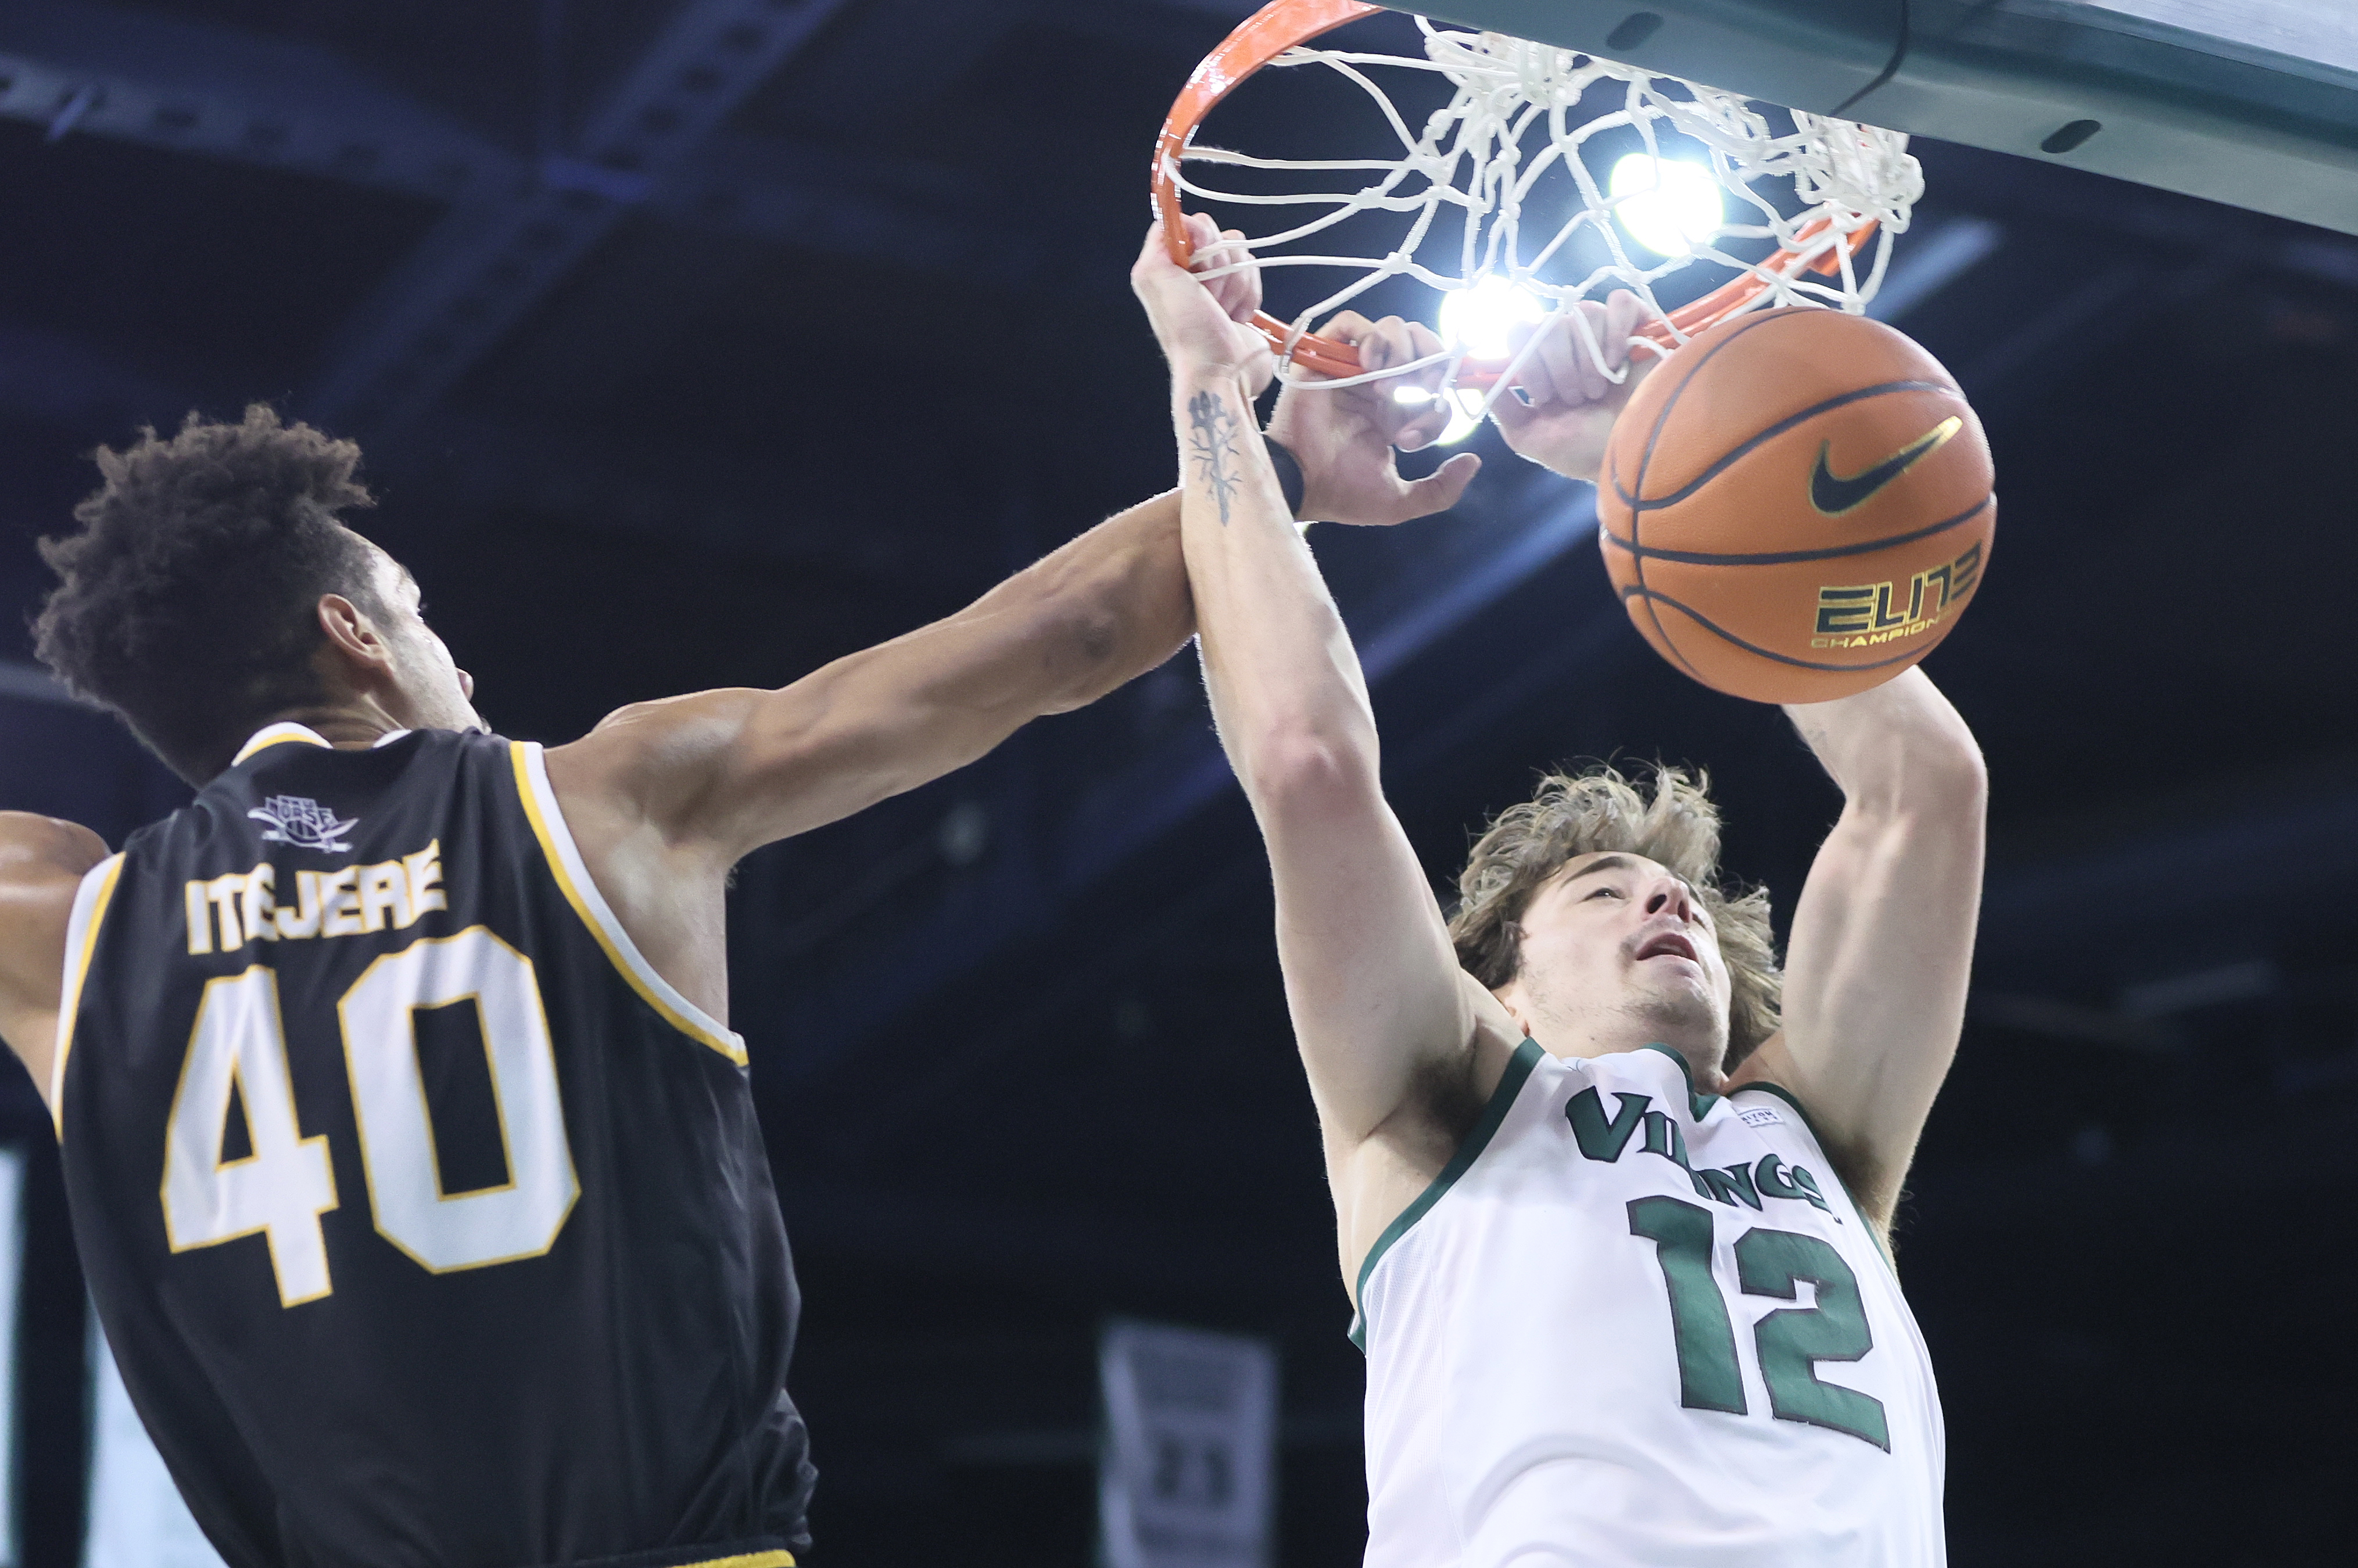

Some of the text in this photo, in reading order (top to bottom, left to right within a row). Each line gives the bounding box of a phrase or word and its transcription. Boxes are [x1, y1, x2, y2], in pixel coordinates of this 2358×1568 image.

[1811, 609, 1951, 649] CHAMPION
[1814, 540, 1981, 635] ELITE
[185, 838, 448, 956] ITEJERE
[160, 924, 582, 1309] 40
[1625, 1194, 1891, 1455] 12
